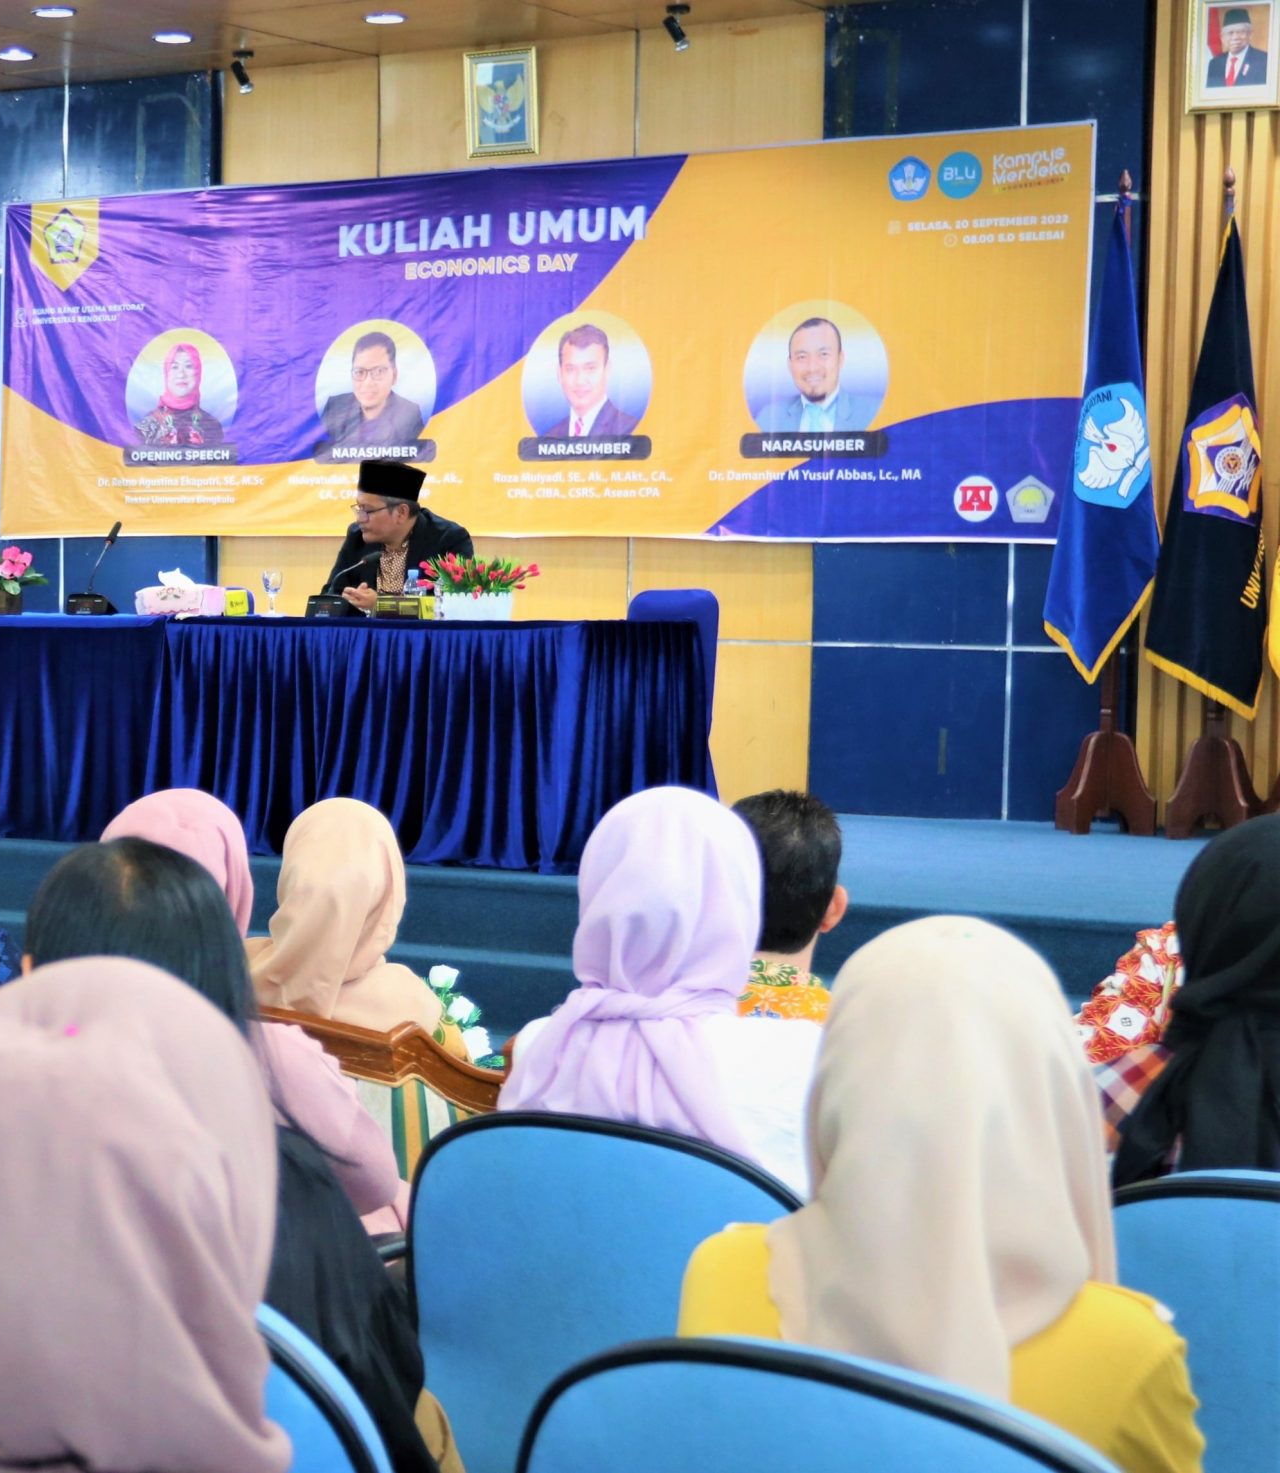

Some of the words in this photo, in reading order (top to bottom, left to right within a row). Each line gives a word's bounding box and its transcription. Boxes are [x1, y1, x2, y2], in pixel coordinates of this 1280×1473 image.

[992, 147, 1066, 170] Kampus
[943, 166, 976, 182] BLU
[992, 161, 1072, 185] Merdeka
[955, 219, 969, 229] 20
[972, 216, 1037, 228] SEPTEMBER
[338, 214, 491, 257] KULIAH
[508, 205, 646, 246] UMUM
[1019, 230, 1065, 242] SELESAI
[404, 255, 531, 281] ECONOMICS
[537, 252, 579, 273] DAY
[332, 446, 418, 459] NARASUMBER
[538, 442, 631, 456] NARASUMBER
[762, 439, 865, 452] NARASUMBER
[131, 450, 183, 461] OPENING
[184, 449, 230, 461] SPEECH
[709, 470, 725, 481] Dr.
[726, 470, 786, 481] Damanhur
[787, 470, 800, 481] M
[802, 468, 835, 481] Yusuf
[836, 468, 876, 482] Abbas,
[902, 469, 922, 481] MA
[638, 486, 660, 497] CPA
